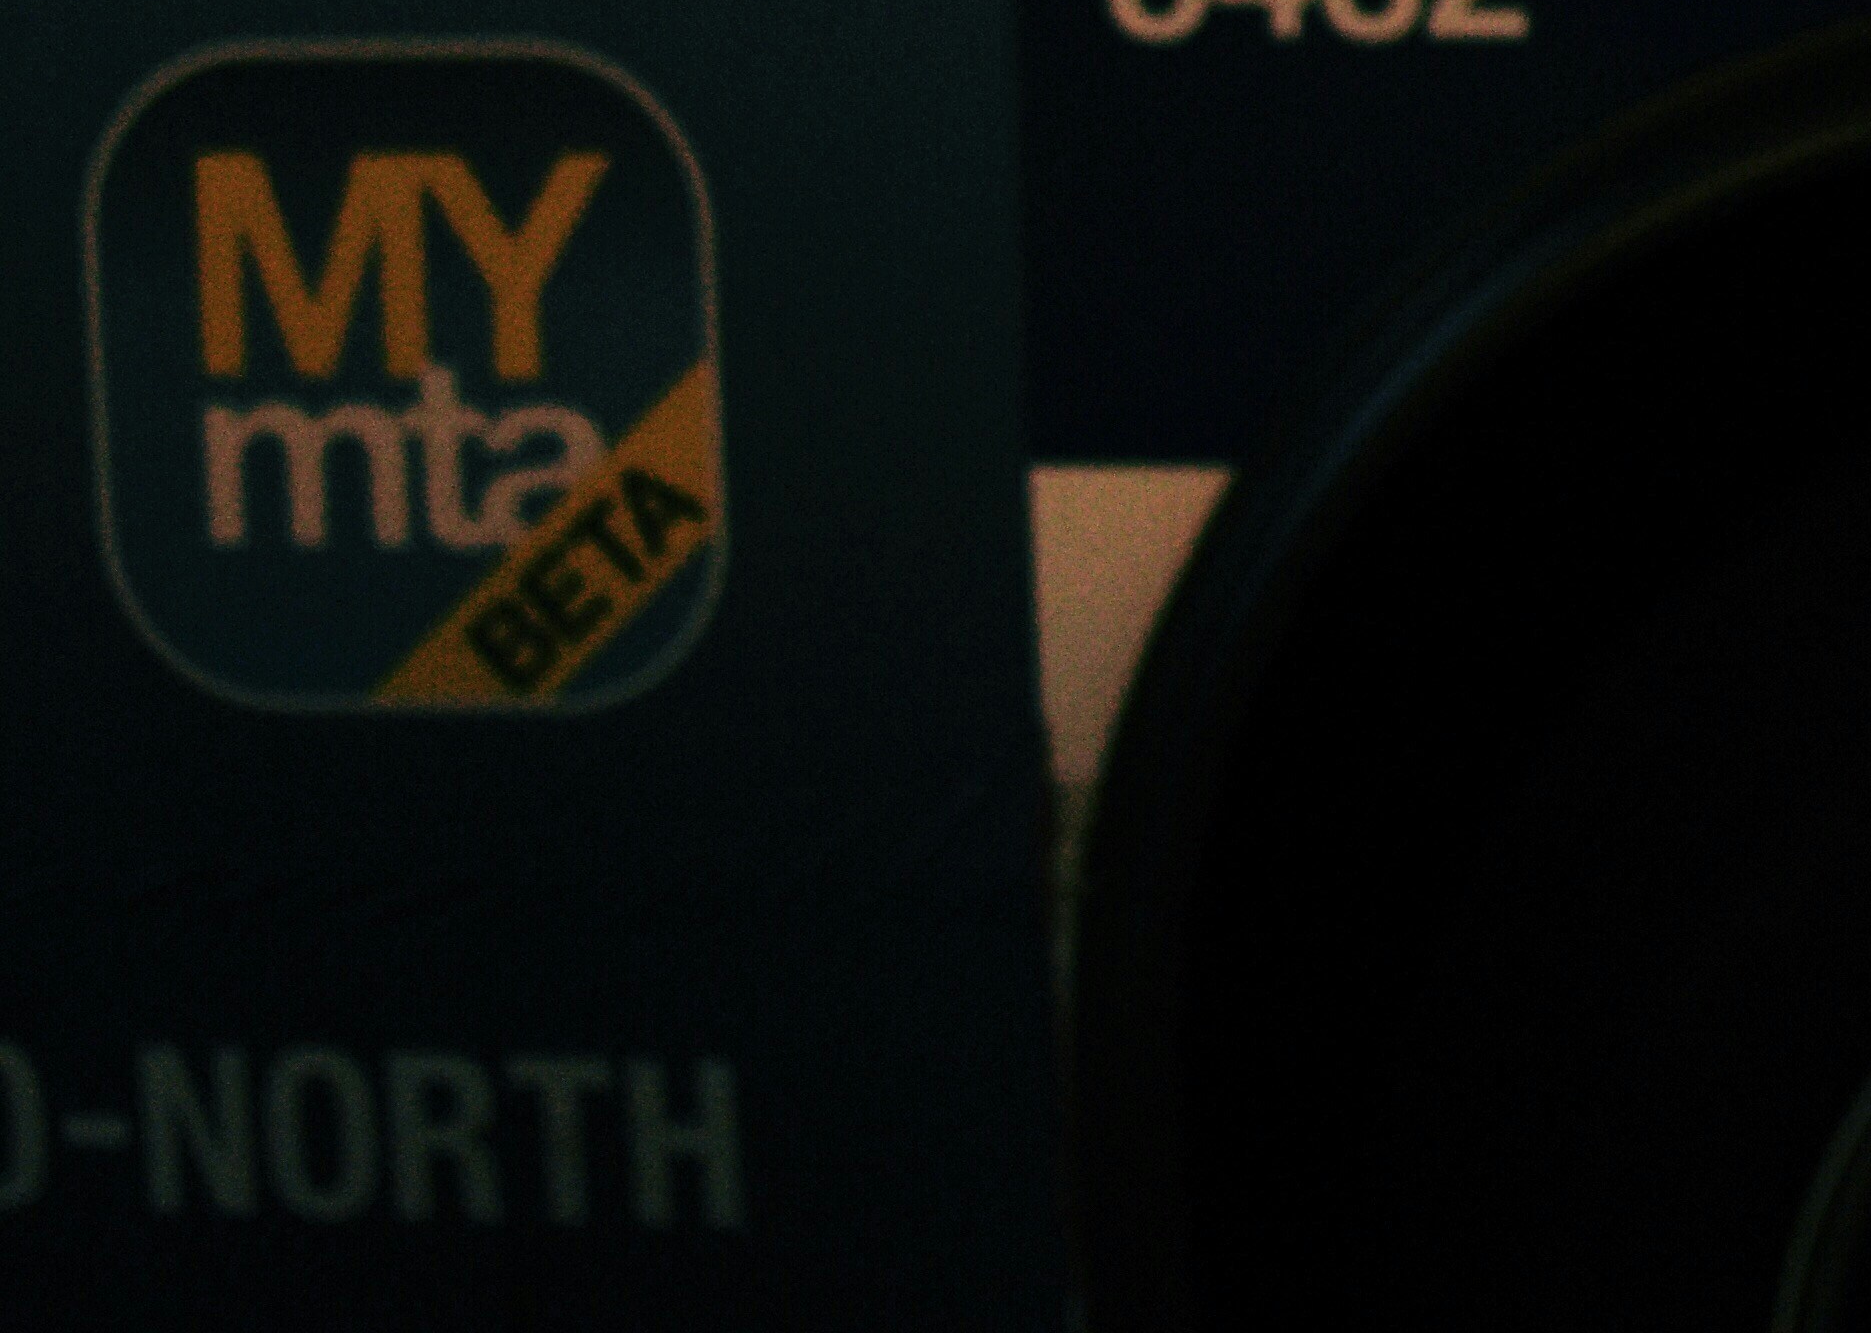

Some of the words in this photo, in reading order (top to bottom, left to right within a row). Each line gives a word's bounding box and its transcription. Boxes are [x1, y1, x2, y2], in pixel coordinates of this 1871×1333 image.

[194, 148, 612, 382] MY
[204, 364, 608, 547] mta
[465, 470, 707, 693] BETA
